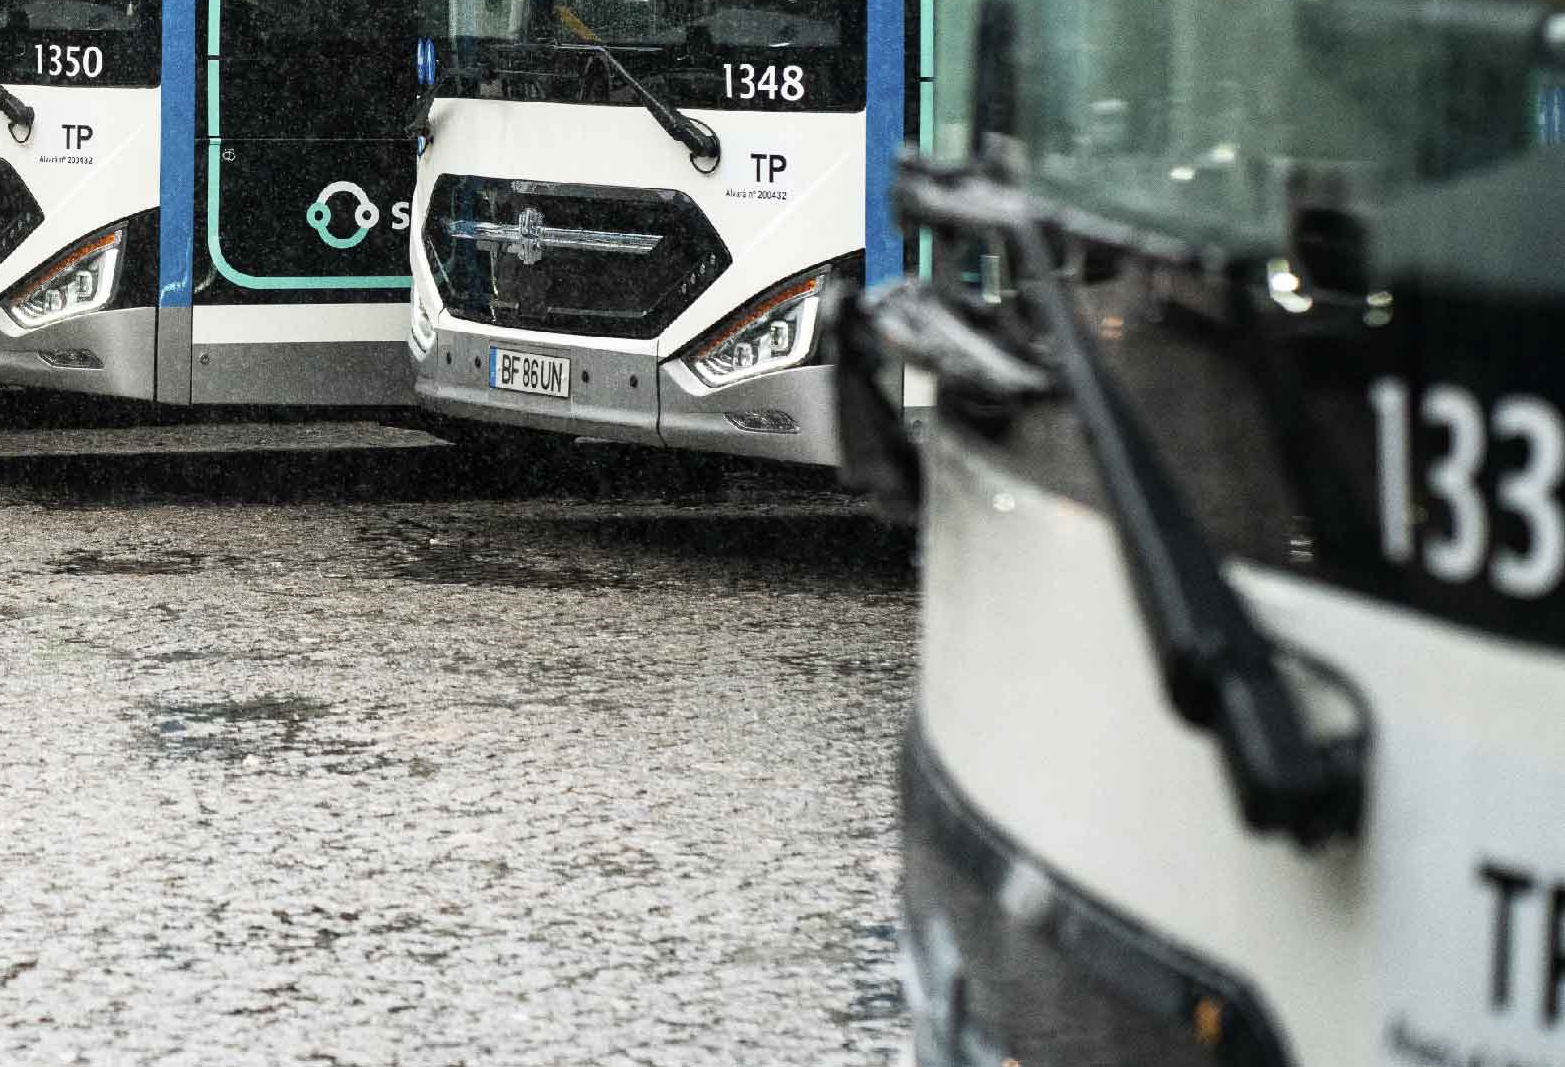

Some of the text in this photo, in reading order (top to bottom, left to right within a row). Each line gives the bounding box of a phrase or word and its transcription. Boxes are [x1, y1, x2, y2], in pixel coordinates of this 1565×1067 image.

[34, 44, 103, 77] 1350
[723, 63, 805, 101] 1348
[61, 124, 93, 149] TP
[750, 153, 787, 183] TP
